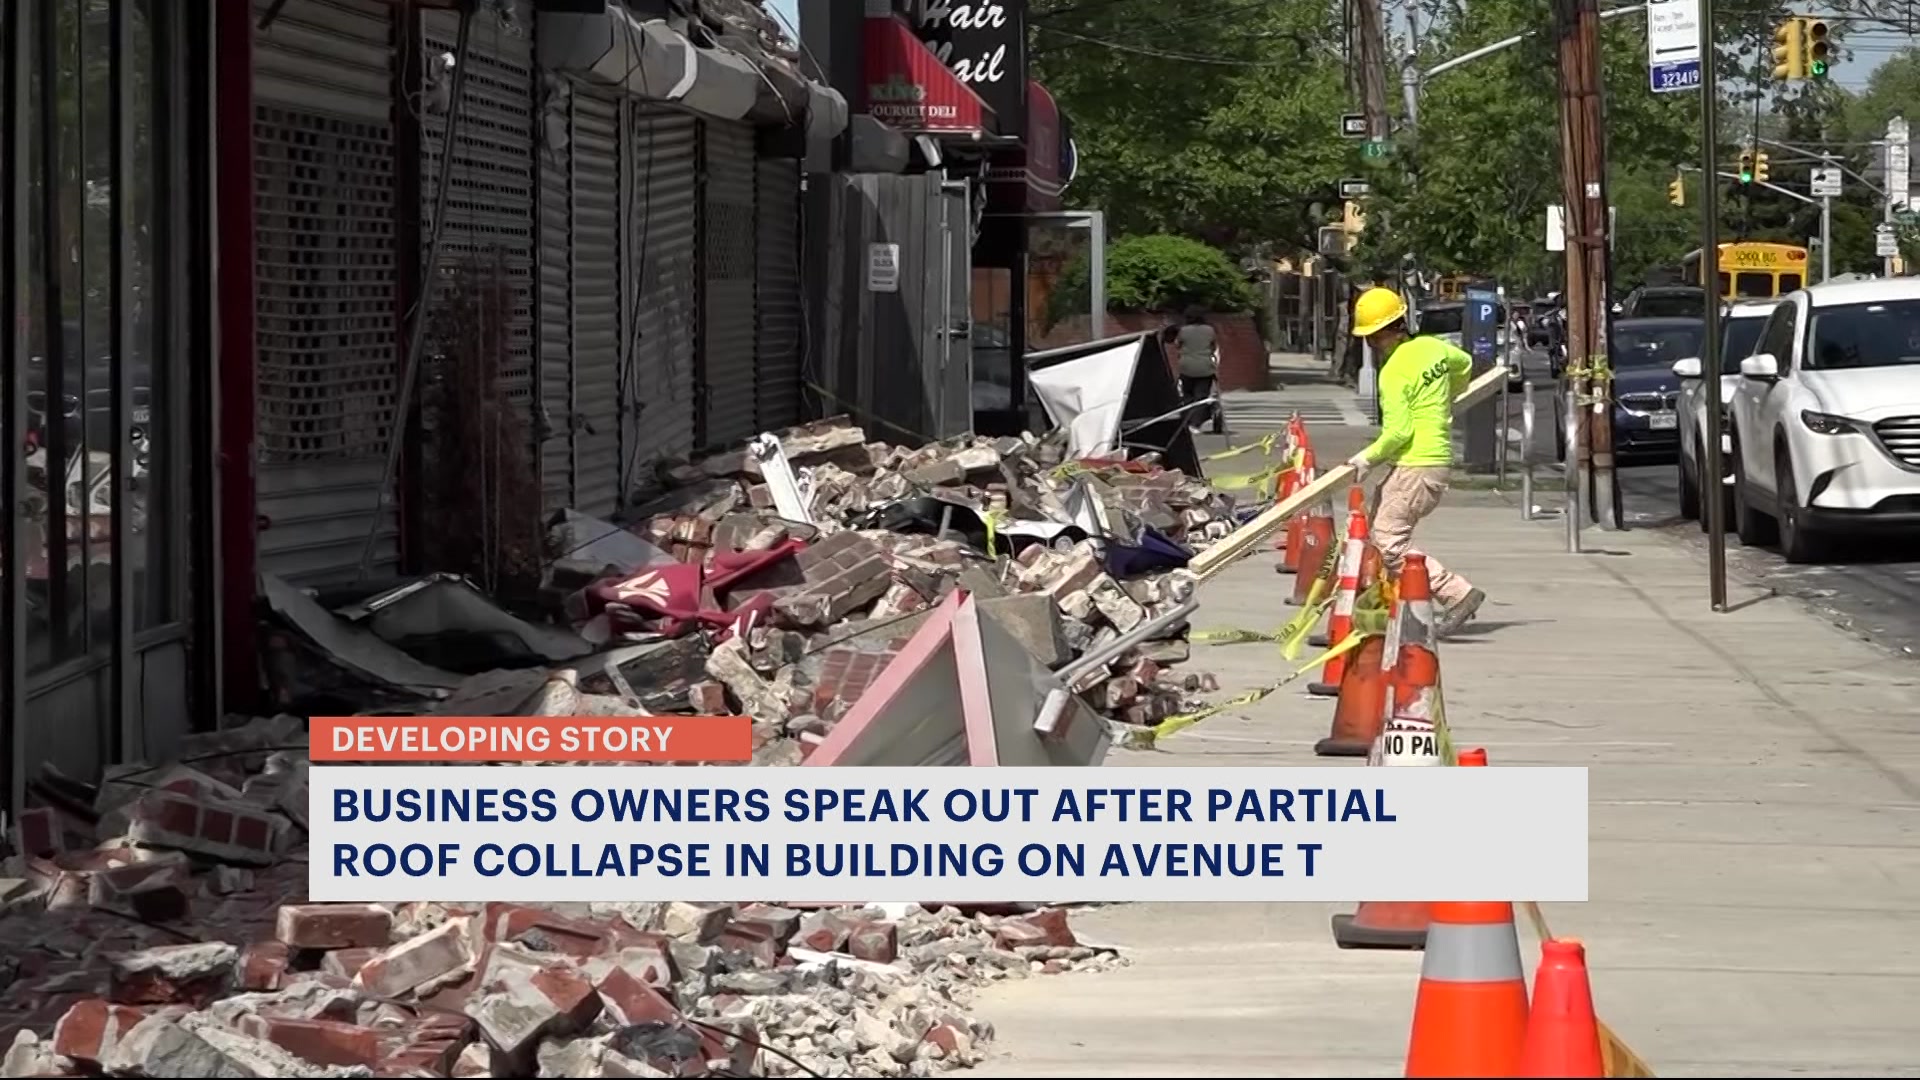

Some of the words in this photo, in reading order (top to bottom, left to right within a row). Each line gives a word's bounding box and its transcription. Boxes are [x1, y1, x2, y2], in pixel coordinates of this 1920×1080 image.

[917, 0, 1006, 30] Hair
[928, 105, 957, 117] DELI
[1480, 304, 1492, 321] P
[1384, 735, 1404, 755] NO
